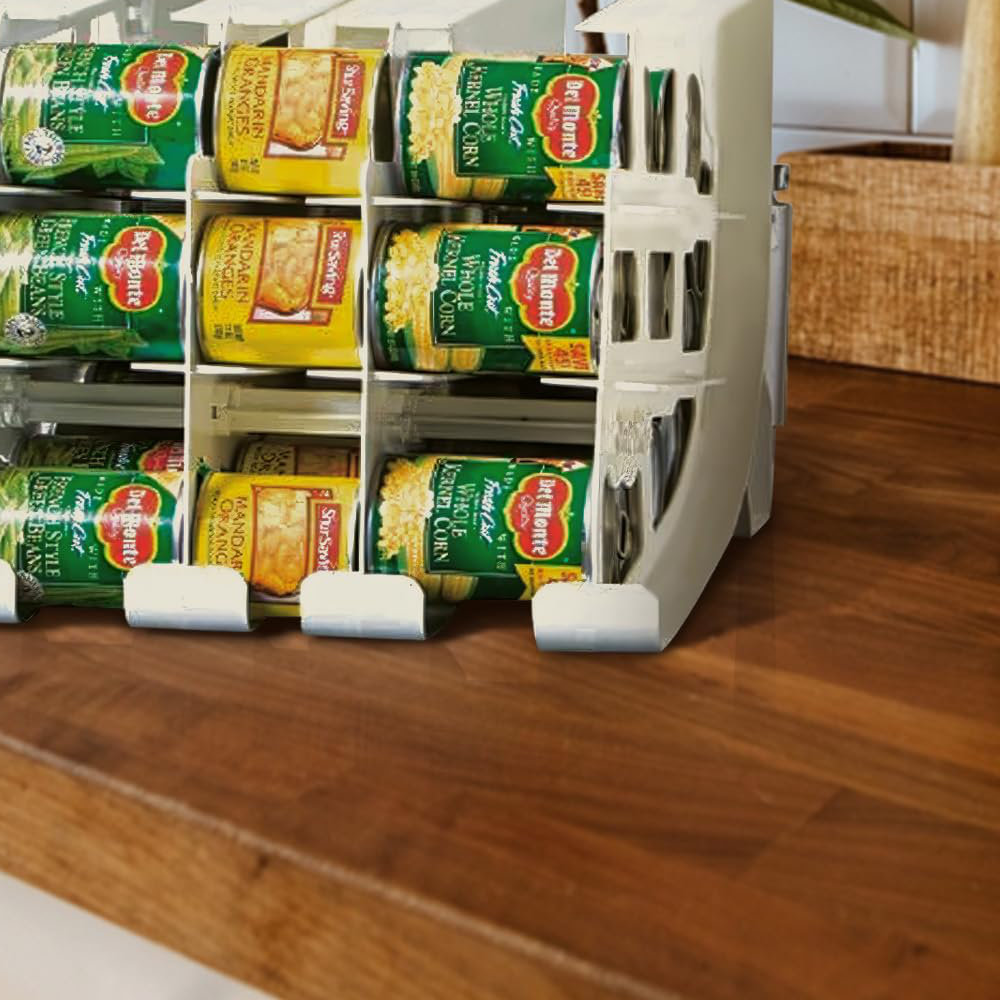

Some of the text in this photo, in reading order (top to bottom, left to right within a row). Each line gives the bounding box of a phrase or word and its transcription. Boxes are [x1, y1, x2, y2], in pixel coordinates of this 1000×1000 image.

[145, 70, 166, 120] Mote
[236, 57, 259, 137] ORANGES
[462, 62, 489, 167] KERNEL CORN
[480, 87, 503, 143] WHOLE
[510, 80, 528, 116] Fresh
[563, 80, 583, 102] Del
[561, 105, 580, 159] Monte
[440, 232, 467, 336] KERNEL CORN
[457, 255, 480, 312] WHOLE
[485, 248, 506, 318] Fresh Cut
[543, 248, 562, 270] Del
[29, 265, 50, 316] BEANS
[48, 274, 67, 320] STYLE
[540, 274, 558, 327] Monte
[433, 460, 462, 563] KERNEL CORN
[451, 483, 475, 538] WHOLE
[481, 478, 501, 512] Fresh
[537, 479, 556, 499] Del
[25, 522, 45, 574] BEANS
[45, 531, 62, 577] STYLE
[216, 499, 233, 565] ORANG
[230, 496, 248, 570] MANDAR
[532, 502, 552, 555] Monte
